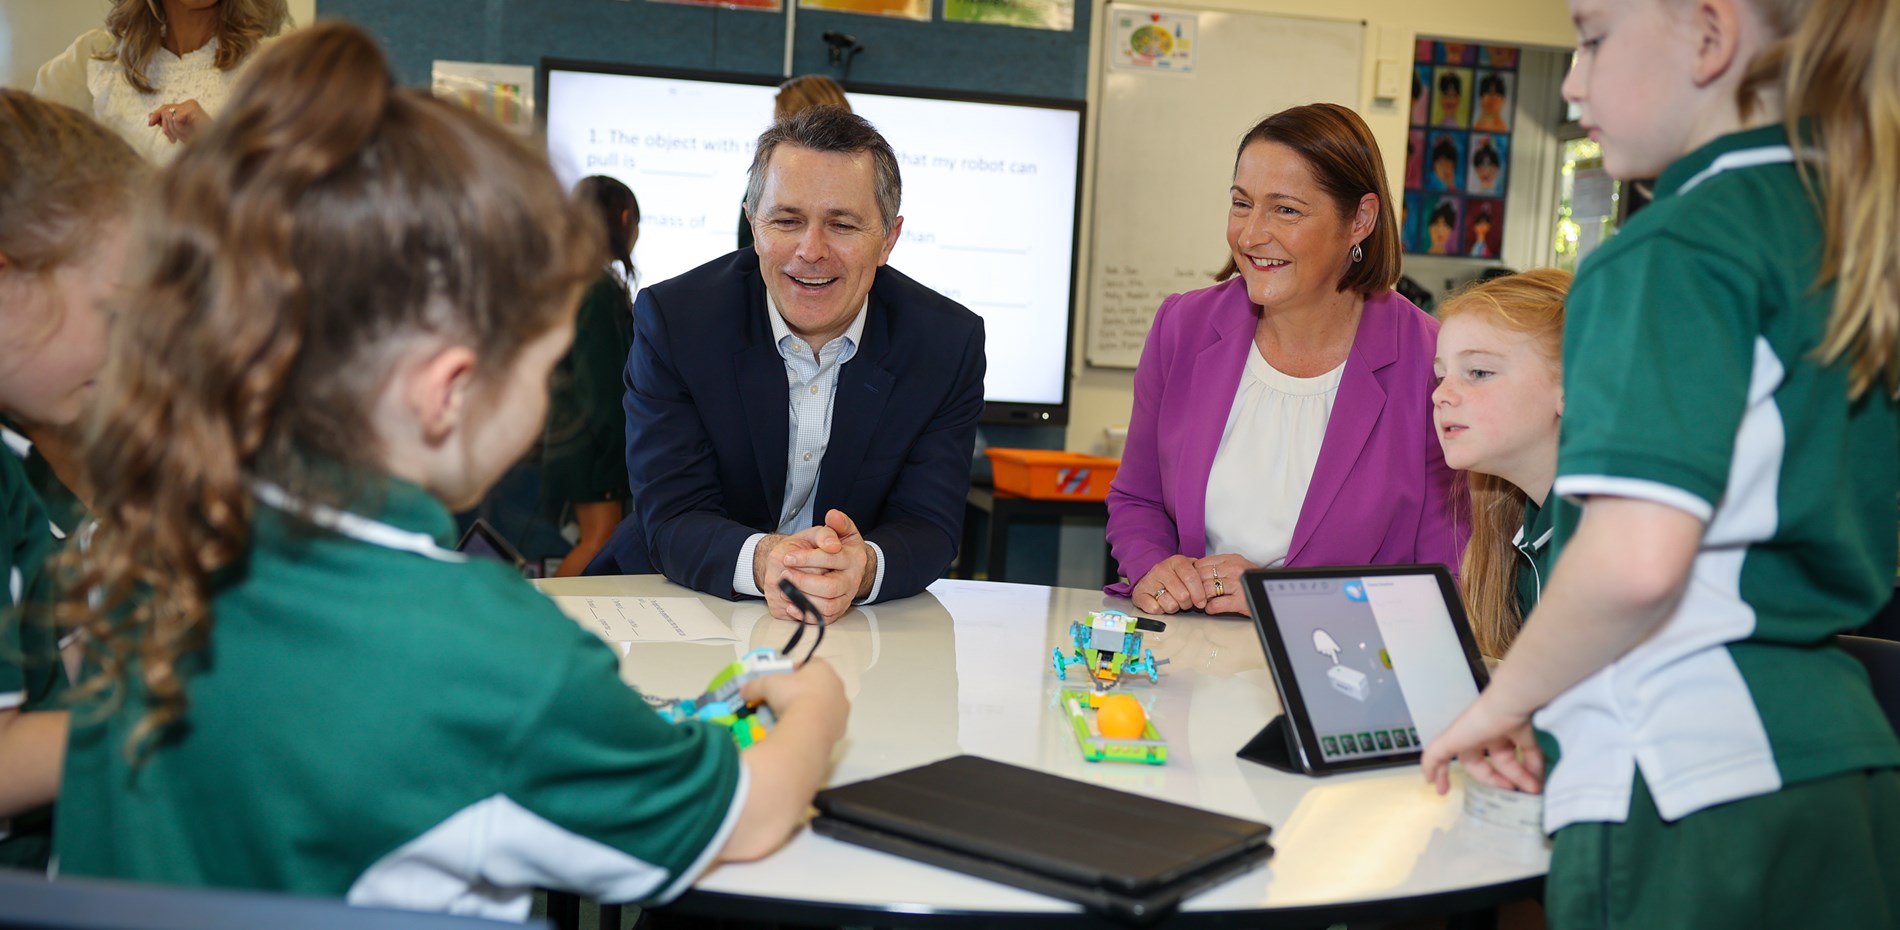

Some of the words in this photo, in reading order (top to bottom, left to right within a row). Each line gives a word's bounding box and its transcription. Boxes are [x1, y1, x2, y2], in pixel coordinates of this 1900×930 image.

[586, 152, 618, 168] pull
[622, 155, 636, 168] is
[610, 129, 640, 145] The
[645, 131, 697, 151] object
[703, 137, 740, 152] with
[932, 156, 957, 172] my
[961, 156, 1005, 173] robot
[1009, 162, 1038, 175] can
[640, 214, 684, 227] mass
[688, 213, 705, 229] of
